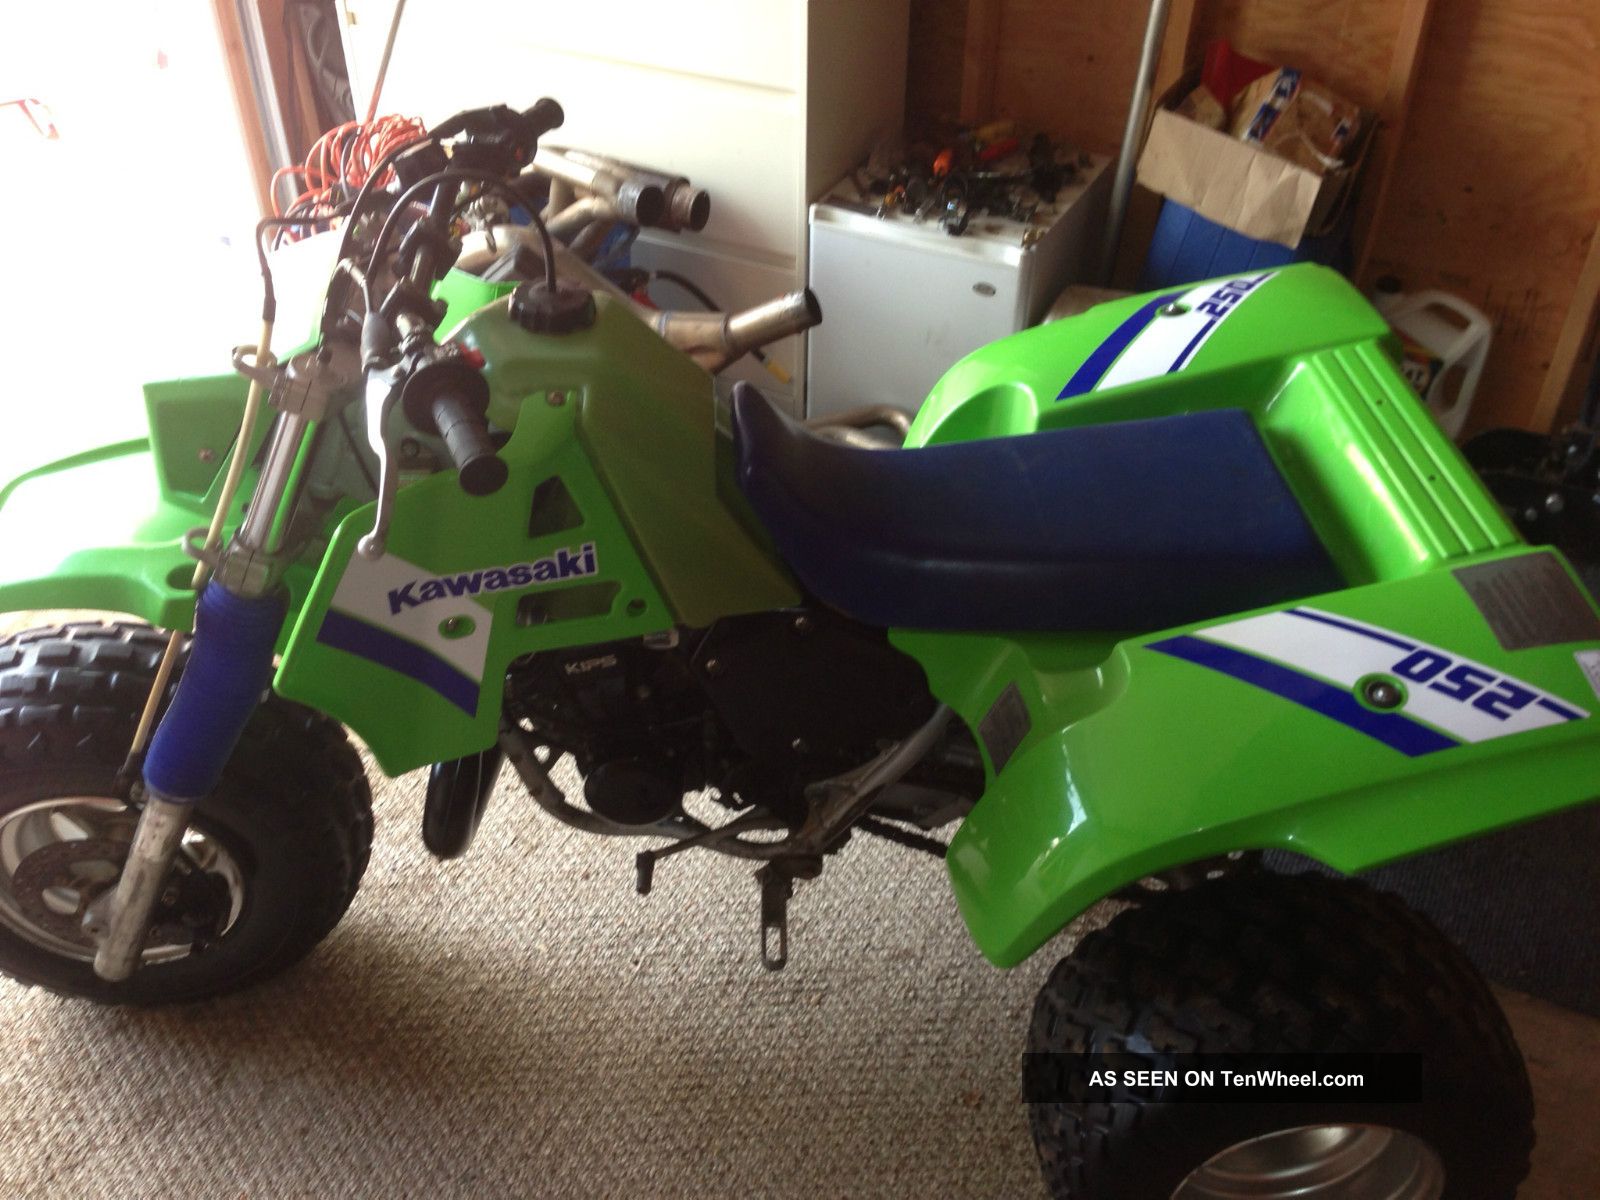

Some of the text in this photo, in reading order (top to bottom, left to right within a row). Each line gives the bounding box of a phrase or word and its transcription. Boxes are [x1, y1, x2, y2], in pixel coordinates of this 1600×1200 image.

[1196, 280, 1255, 318] 250
[387, 544, 596, 615] Kawasaki
[564, 654, 617, 675] KIPS
[1391, 649, 1539, 722] 250
